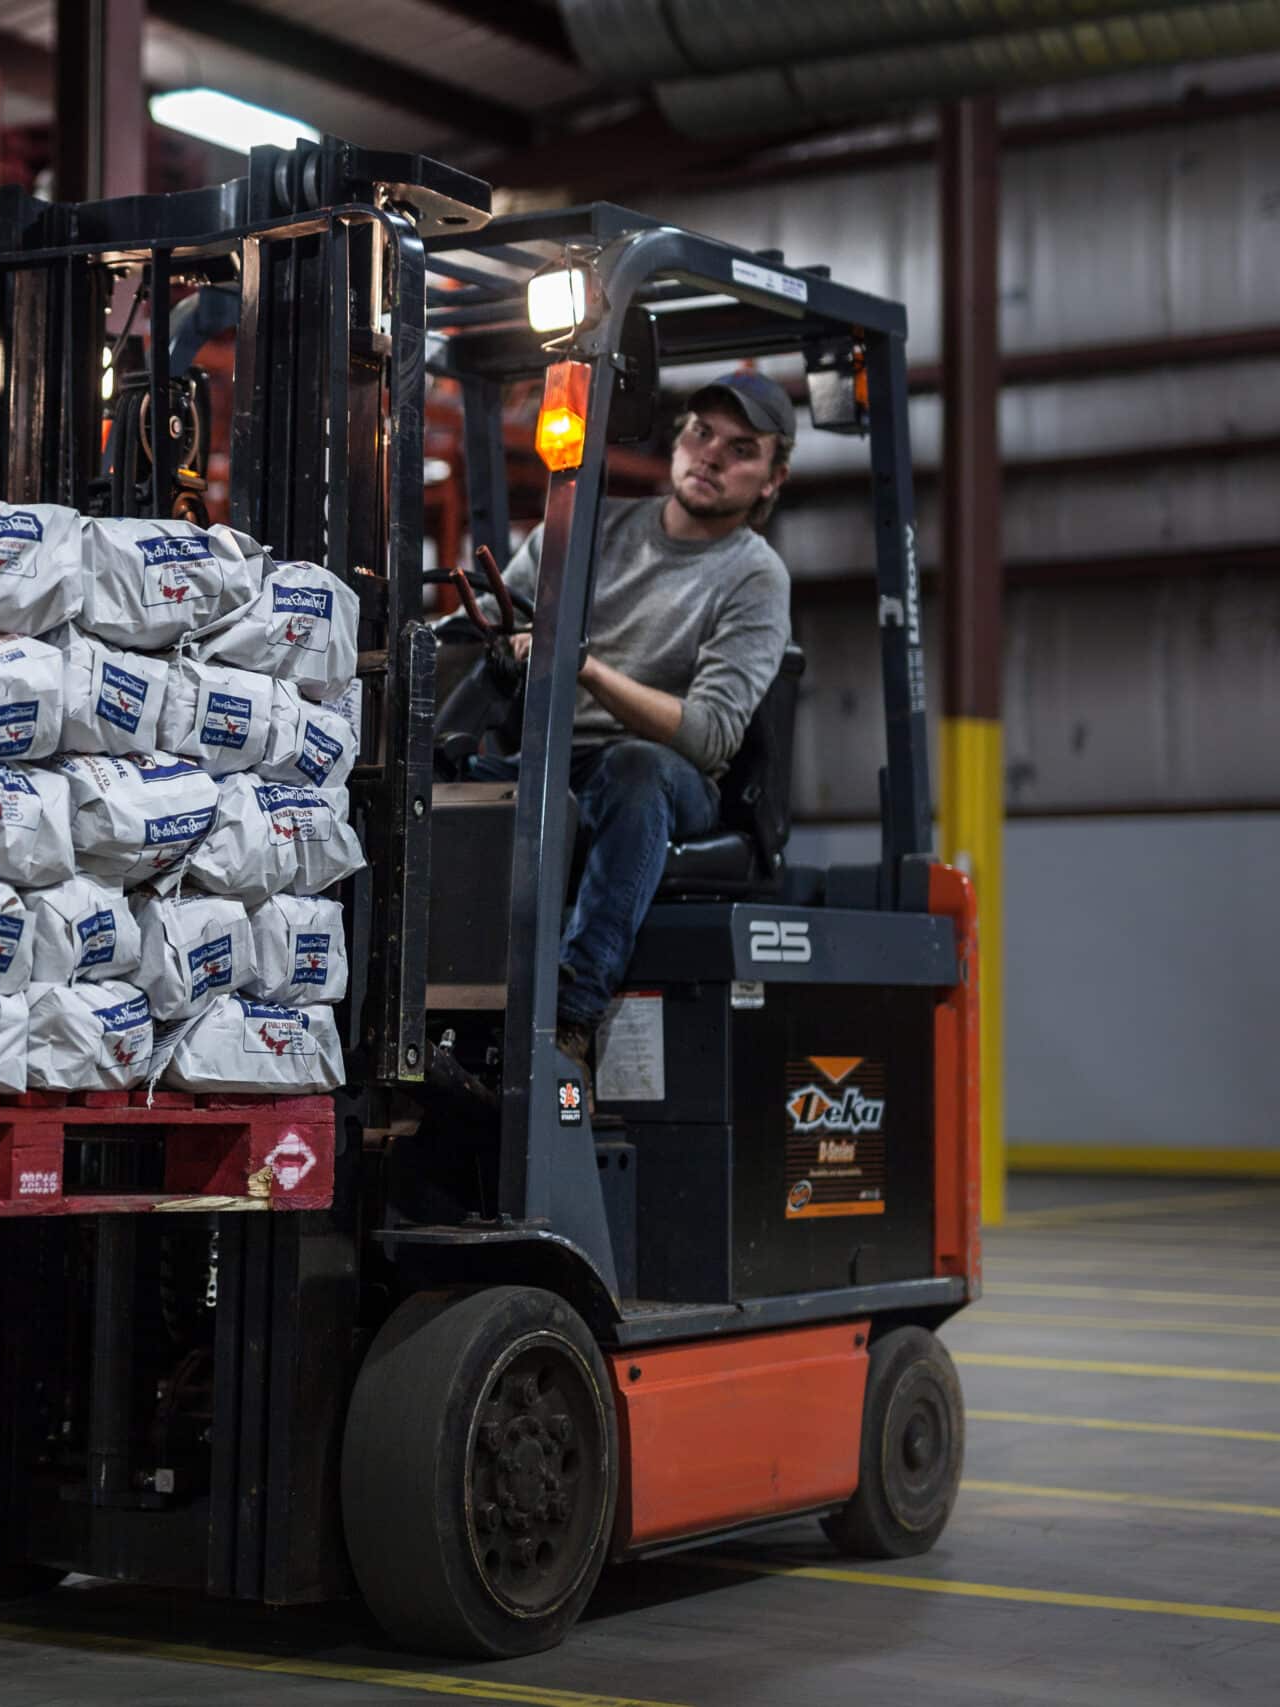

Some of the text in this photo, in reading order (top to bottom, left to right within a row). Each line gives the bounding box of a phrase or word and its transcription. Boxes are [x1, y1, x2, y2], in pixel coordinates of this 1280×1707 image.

[749, 920, 811, 962] 25
[559, 1082, 580, 1108] SAS
[786, 1084, 885, 1134] Deka
